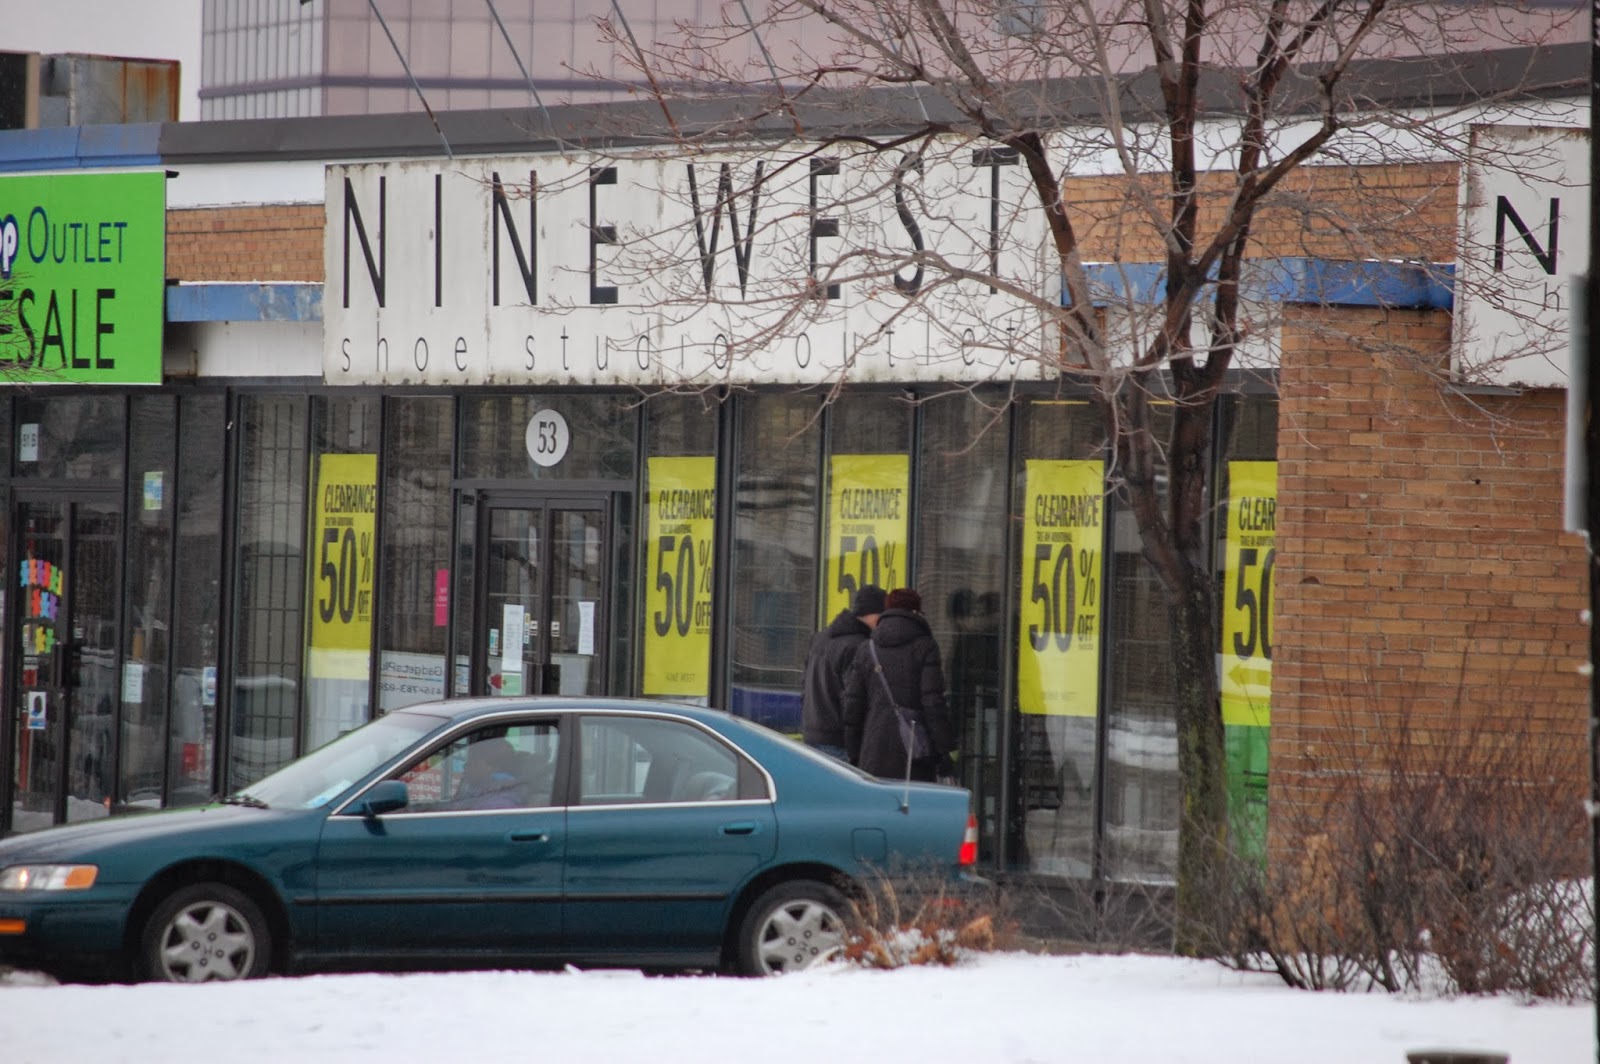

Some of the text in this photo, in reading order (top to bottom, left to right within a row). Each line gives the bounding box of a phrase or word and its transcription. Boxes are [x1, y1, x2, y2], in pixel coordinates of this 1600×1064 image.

[343, 147, 1020, 308] NINE WEST
[342, 312, 1017, 373] shoe studio outlet
[537, 420, 557, 454] 53
[324, 484, 376, 513] CLEARANCE
[659, 489, 714, 520] CLEARANCE
[840, 488, 902, 520] CLEARANCE
[1035, 494, 1101, 528] CLEARANCE
[1078, 614, 1096, 642] OFF
